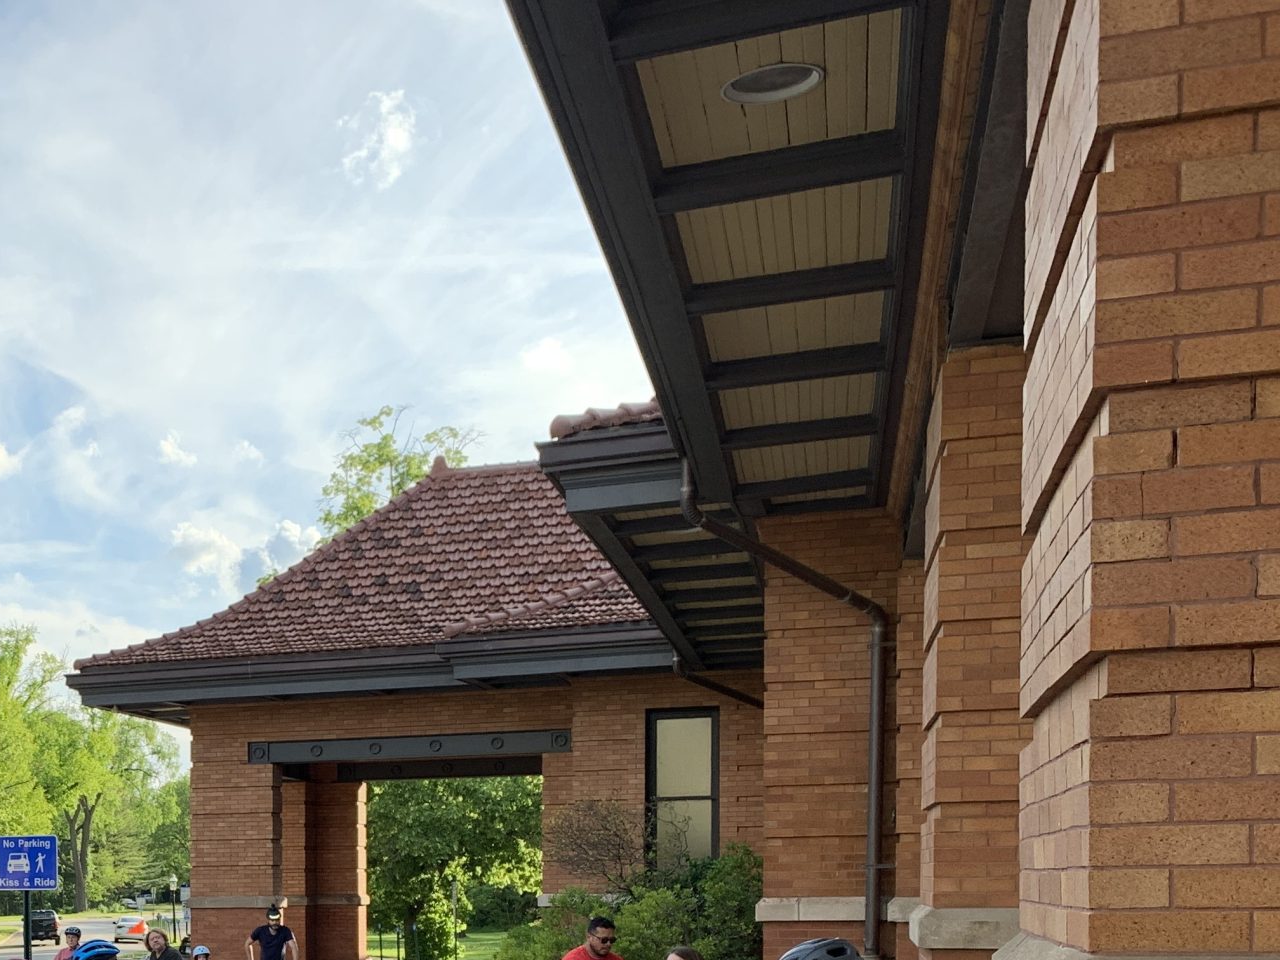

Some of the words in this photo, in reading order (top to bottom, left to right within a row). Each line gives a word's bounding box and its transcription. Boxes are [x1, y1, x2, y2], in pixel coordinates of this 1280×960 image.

[3, 840, 15, 848] No
[18, 840, 51, 849] Parking
[0, 879, 20, 887] Kiss
[23, 878, 31, 887] &
[34, 878, 55, 887] Ride
